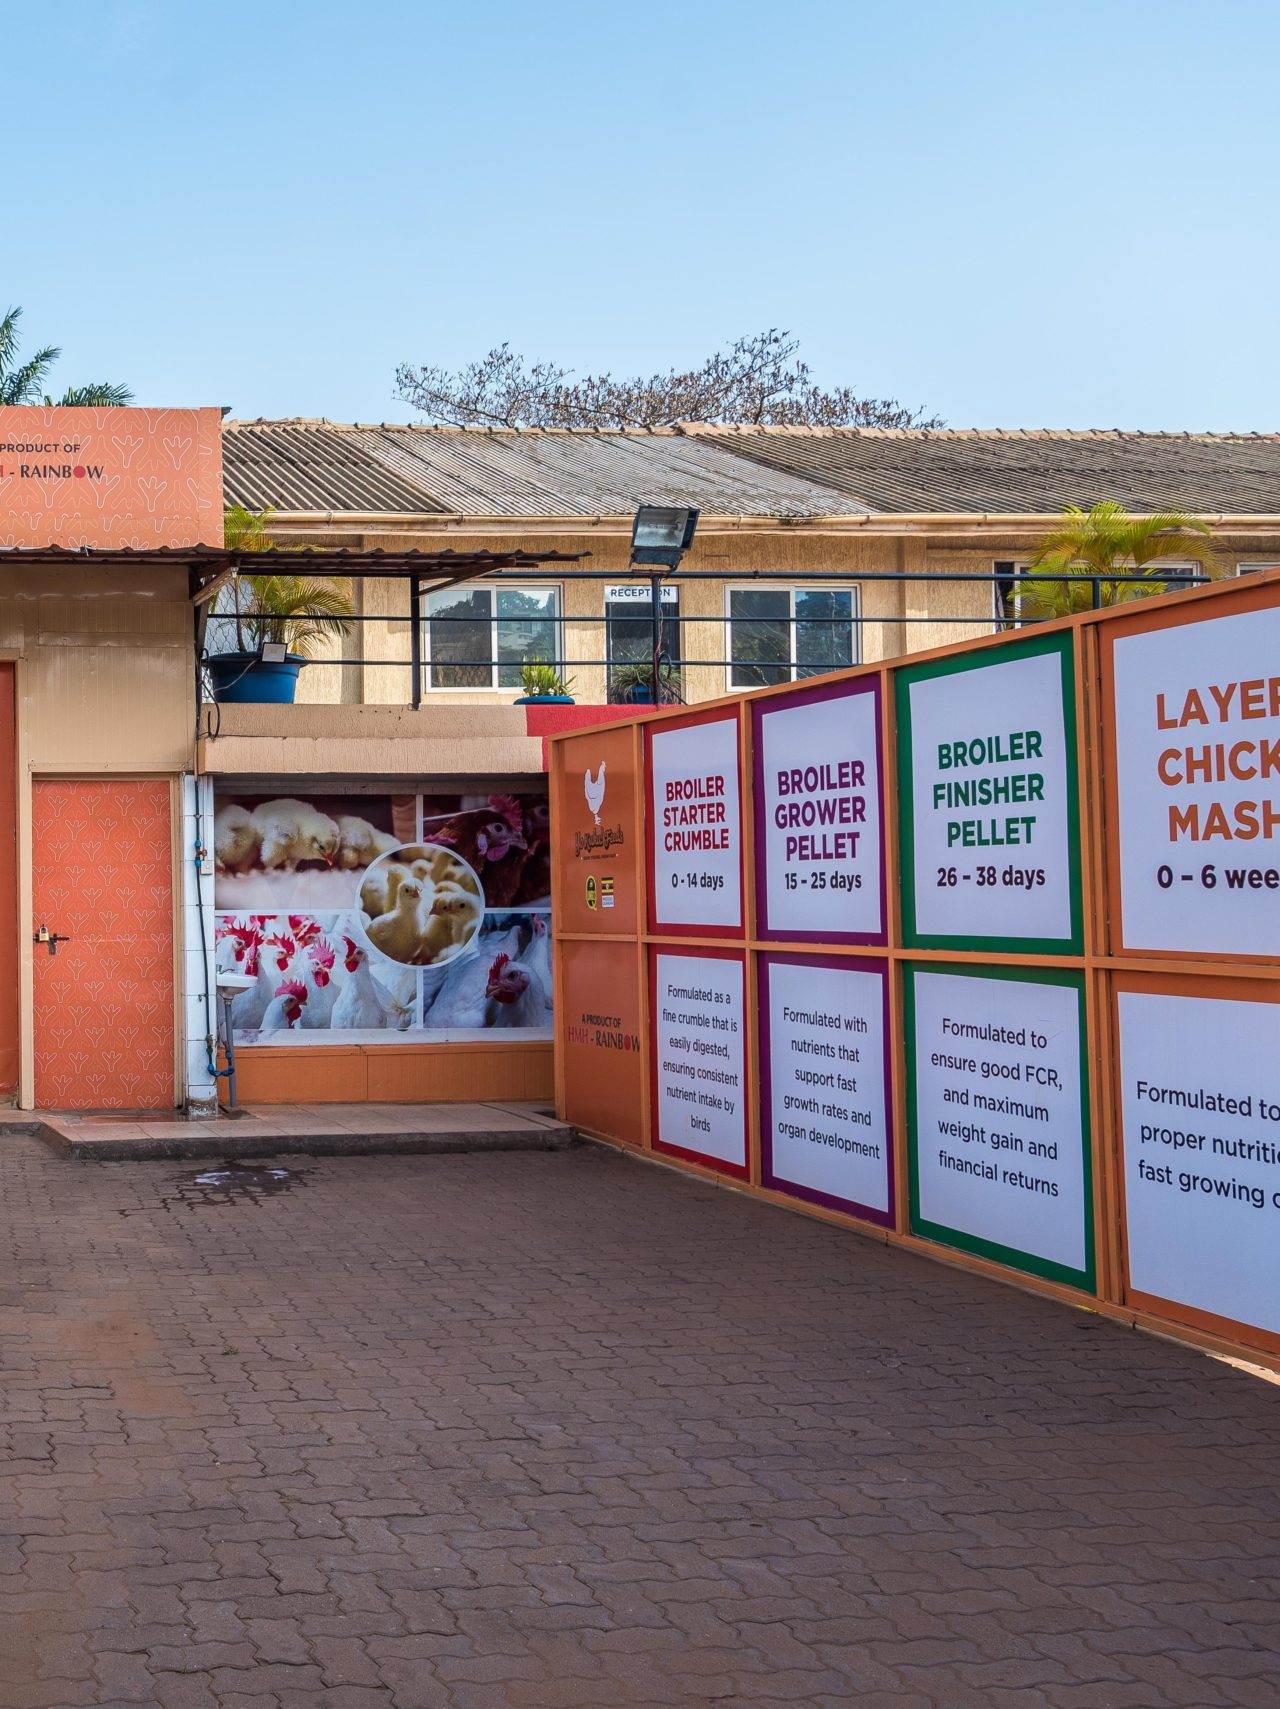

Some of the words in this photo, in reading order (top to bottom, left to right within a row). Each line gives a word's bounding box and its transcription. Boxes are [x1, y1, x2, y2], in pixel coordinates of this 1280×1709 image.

[0, 444, 60, 453] PRODUCT
[63, 444, 81, 453] OF
[20, 465, 104, 478] RAINBOW
[610, 588, 671, 597] RECEPTN
[937, 730, 1043, 770] BROILER
[665, 775, 724, 801] BROILER
[777, 760, 866, 796] BROILER
[933, 773, 1045, 810] FINISHER
[663, 802, 726, 827] STARTER
[775, 796, 866, 829] GROWER
[664, 828, 730, 852] CRUMBLE
[947, 816, 1036, 848] PELLET
[786, 831, 860, 862] PELLET
[671, 873, 677, 888] 0
[687, 873, 698, 888] 14
[700, 872, 724, 891] days
[785, 873, 797, 890] 15
[810, 872, 827, 890] 25
[830, 871, 862, 892] days
[937, 867, 957, 887] 26
[976, 866, 997, 886] 38
[1002, 864, 1046, 890] days
[1157, 865, 1173, 889] 0
[1200, 864, 1217, 889] 6
[667, 985, 712, 1003] Formulated
[714, 992, 723, 1003] as
[725, 993, 731, 1004] a
[581, 1014, 586, 1024] A
[586, 1014, 612, 1027] PRODUCT
[613, 1018, 621, 1028] OF
[662, 1008, 677, 1023] fine
[678, 1010, 710, 1028] crumble
[712, 1016, 729, 1031] that
[730, 1019, 737, 1032] is
[783, 1007, 841, 1030] Formulated
[844, 1015, 868, 1034] with
[942, 1017, 1026, 1046] Formulated
[1030, 1031, 1048, 1049] to
[568, 1026, 589, 1044] HMH
[596, 1030, 640, 1053] RAINBOW
[669, 1036, 690, 1053] easily
[692, 1038, 730, 1060] digested,
[791, 1038, 836, 1058] nutrients
[838, 1044, 860, 1063] that
[663, 1059, 695, 1080] ensuring
[697, 1066, 738, 1086] consistent
[795, 1067, 834, 1088] support
[837, 1073, 857, 1092] fast
[931, 1052, 977, 1073] ensure
[981, 1060, 1021, 1081] good
[1025, 1065, 1063, 1091] FCR,
[666, 1085, 697, 1103] nutrient
[698, 1091, 722, 1108] intake
[724, 1096, 735, 1114] by
[783, 1093, 819, 1114] growth
[822, 1102, 848, 1121] rates
[851, 1110, 871, 1127] and
[943, 1087, 969, 1105] and
[973, 1092, 1049, 1122] maximum
[1136, 1080, 1252, 1117] Formulated
[1259, 1099, 1280, 1121] to
[690, 1114, 711, 1132] birds
[778, 1121, 806, 1142] organ
[809, 1126, 880, 1160] development
[938, 1120, 986, 1145] weight
[990, 1130, 1023, 1152] gain
[1028, 1140, 1058, 1160] and
[1140, 1124, 1206, 1150] proper
[1212, 1137, 1280, 1165] nutriti
[938, 1150, 998, 1182] financial
[1002, 1168, 1059, 1197] returns
[1138, 1159, 1173, 1185] fast
[1179, 1171, 1265, 1208] growing
